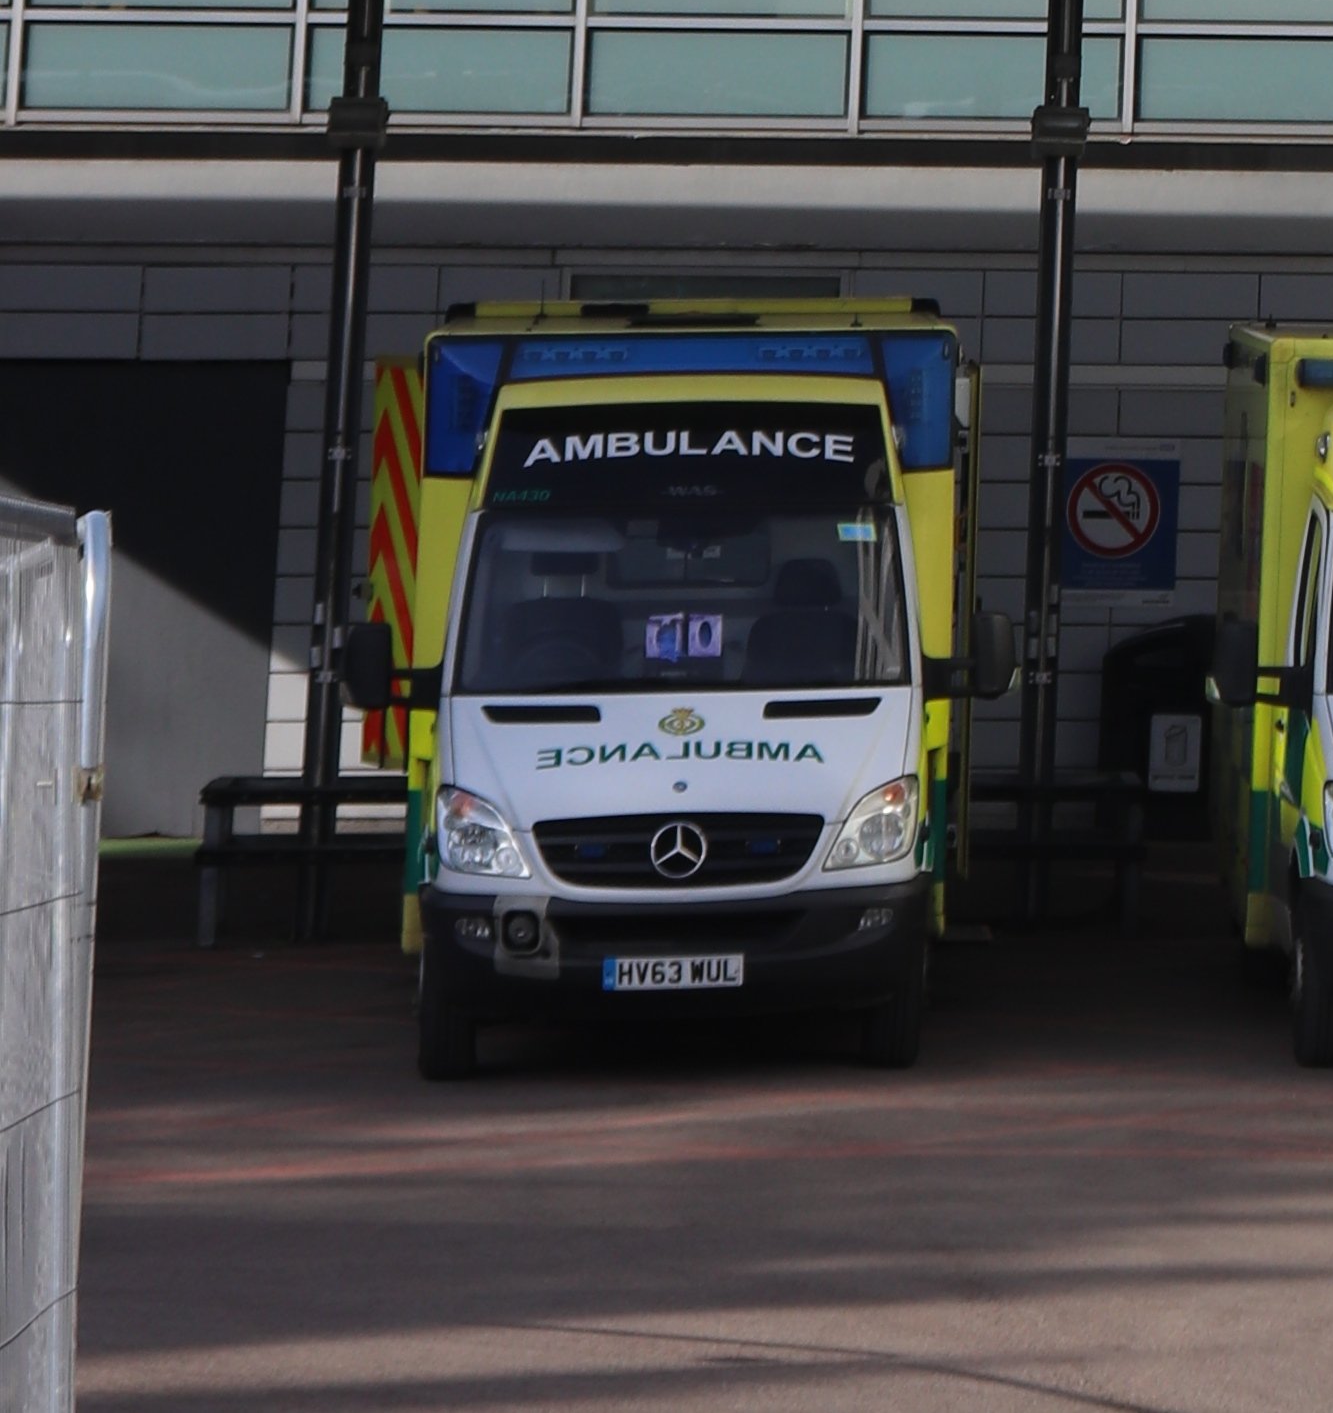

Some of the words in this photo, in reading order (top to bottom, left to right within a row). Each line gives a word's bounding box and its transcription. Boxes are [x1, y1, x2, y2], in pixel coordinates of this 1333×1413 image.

[523, 431, 854, 468] AMBULANCE
[491, 490, 551, 503] NA430
[618, 961, 682, 986] HV63
[690, 959, 736, 983] WUL
